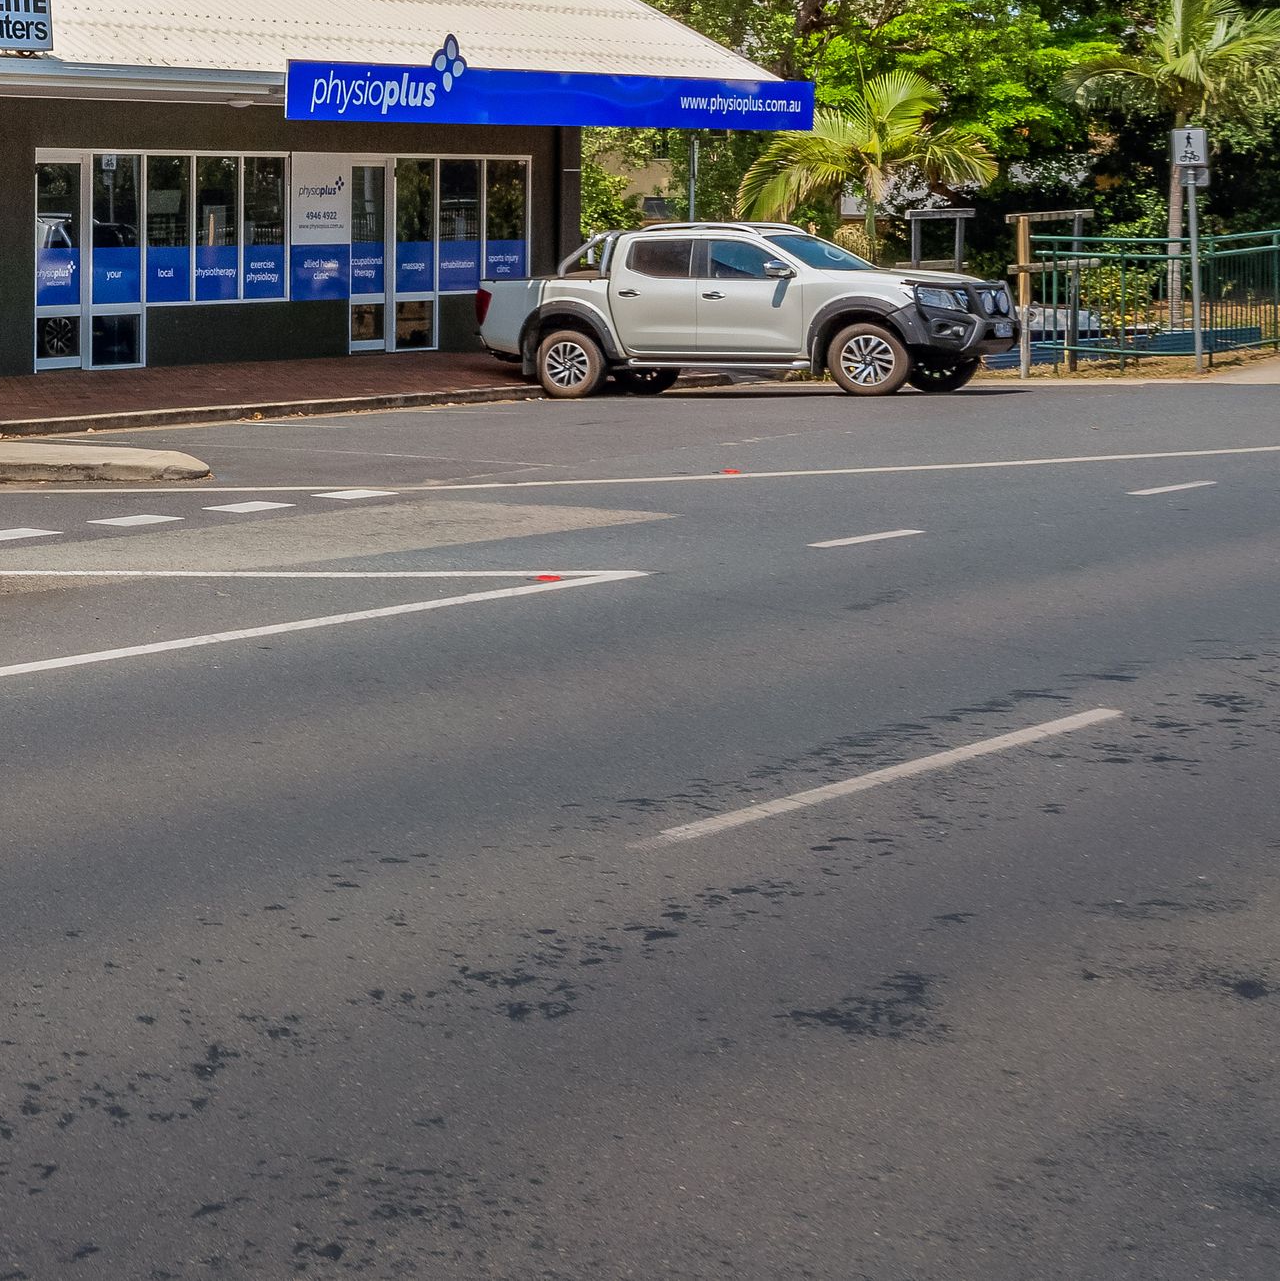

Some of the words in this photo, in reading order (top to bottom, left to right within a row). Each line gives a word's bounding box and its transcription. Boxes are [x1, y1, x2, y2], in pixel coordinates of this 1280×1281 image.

[310, 70, 437, 115] physioplus
[680, 94, 801, 115] www.physioplus.com.au
[298, 185, 337, 198] physioplus
[306, 211, 321, 220] 4946
[322, 211, 337, 220] 4922
[351, 256, 383, 266] ccupational
[488, 254, 504, 263] sports
[250, 260, 275, 268] exercise
[304, 259, 319, 268] allied
[321, 259, 338, 269] health
[402, 262, 425, 272] massage
[440, 260, 475, 269] rehabilitation
[106, 270, 122, 280] your
[157, 268, 174, 277] local
[246, 271, 279, 283] physiology
[313, 270, 330, 280] clinic
[354, 268, 376, 279] therapy
